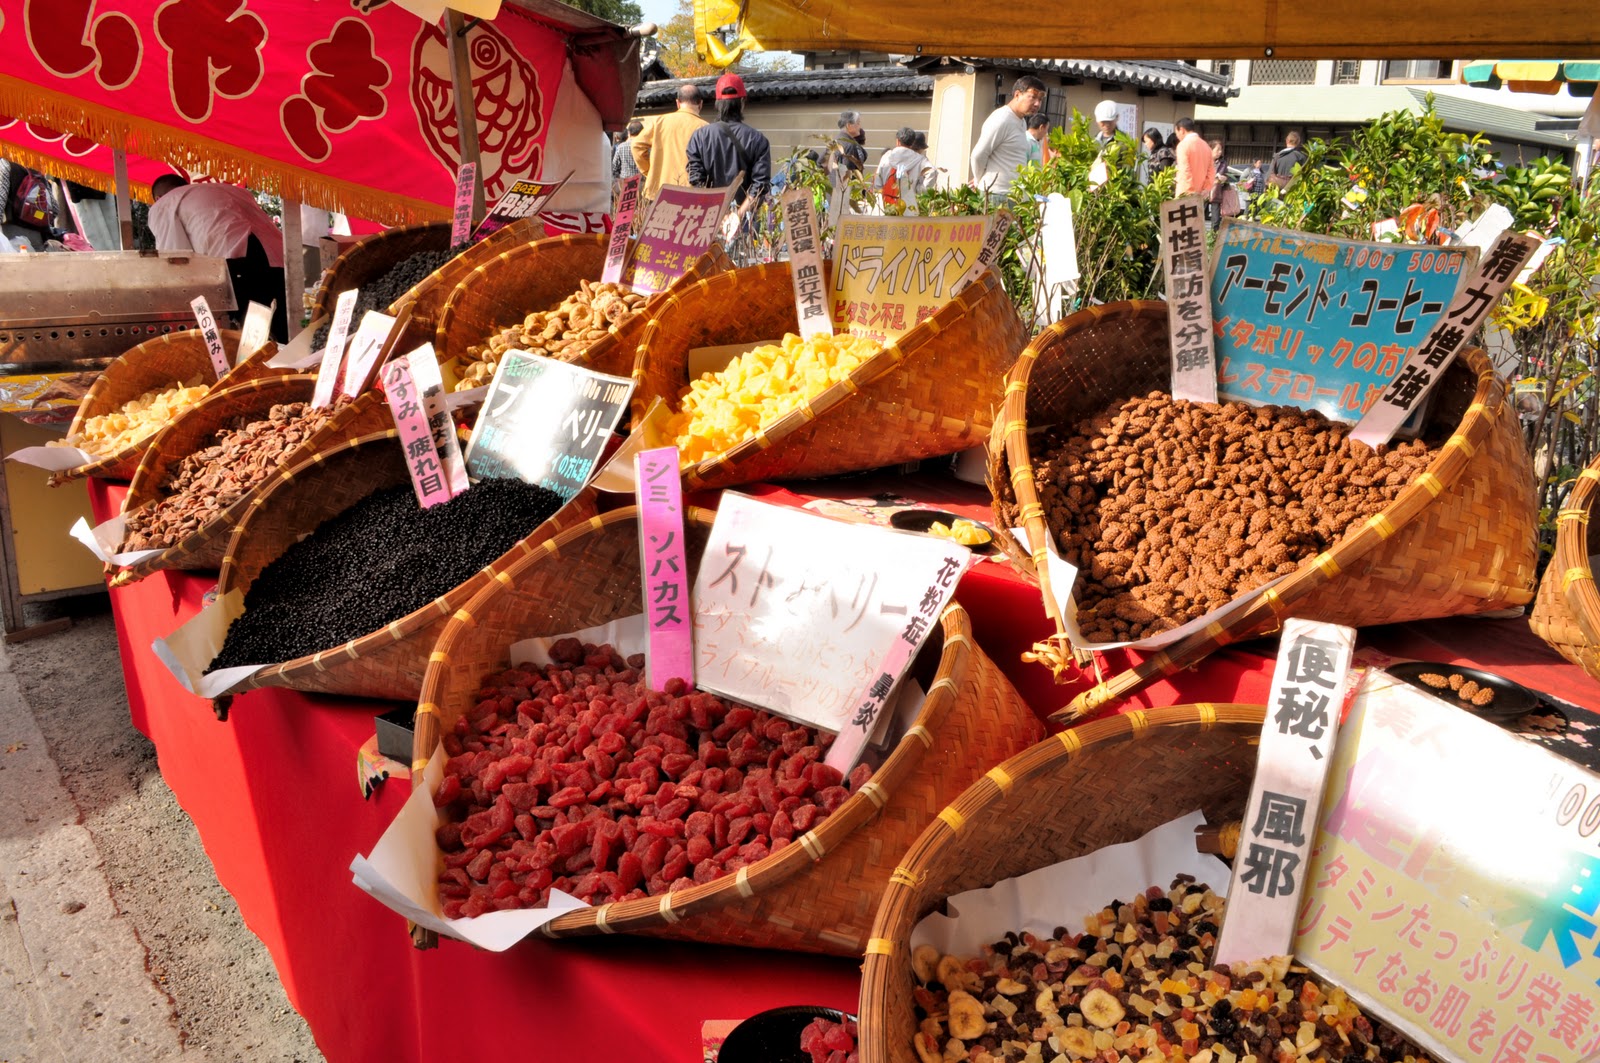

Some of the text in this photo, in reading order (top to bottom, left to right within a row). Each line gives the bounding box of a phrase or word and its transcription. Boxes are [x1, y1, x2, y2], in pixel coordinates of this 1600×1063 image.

[644, 200, 720, 248] 無花果
[836, 244, 973, 299] ドライパイン
[950, 224, 981, 243] 600円
[1167, 204, 1210, 373] 中性脂肪を分解
[1342, 245, 1395, 272] 100g
[1406, 251, 1463, 276] 500円
[1383, 236, 1531, 412] 精力増強
[389, 364, 444, 498] かすみ・疲れ目
[491, 382, 611, 450] ブベリー
[643, 461, 682, 628] シミ、ソバカス
[1240, 634, 1341, 899] 便秘、風邪
[1311, 844, 1600, 1056] タミンたっぷり栄養
